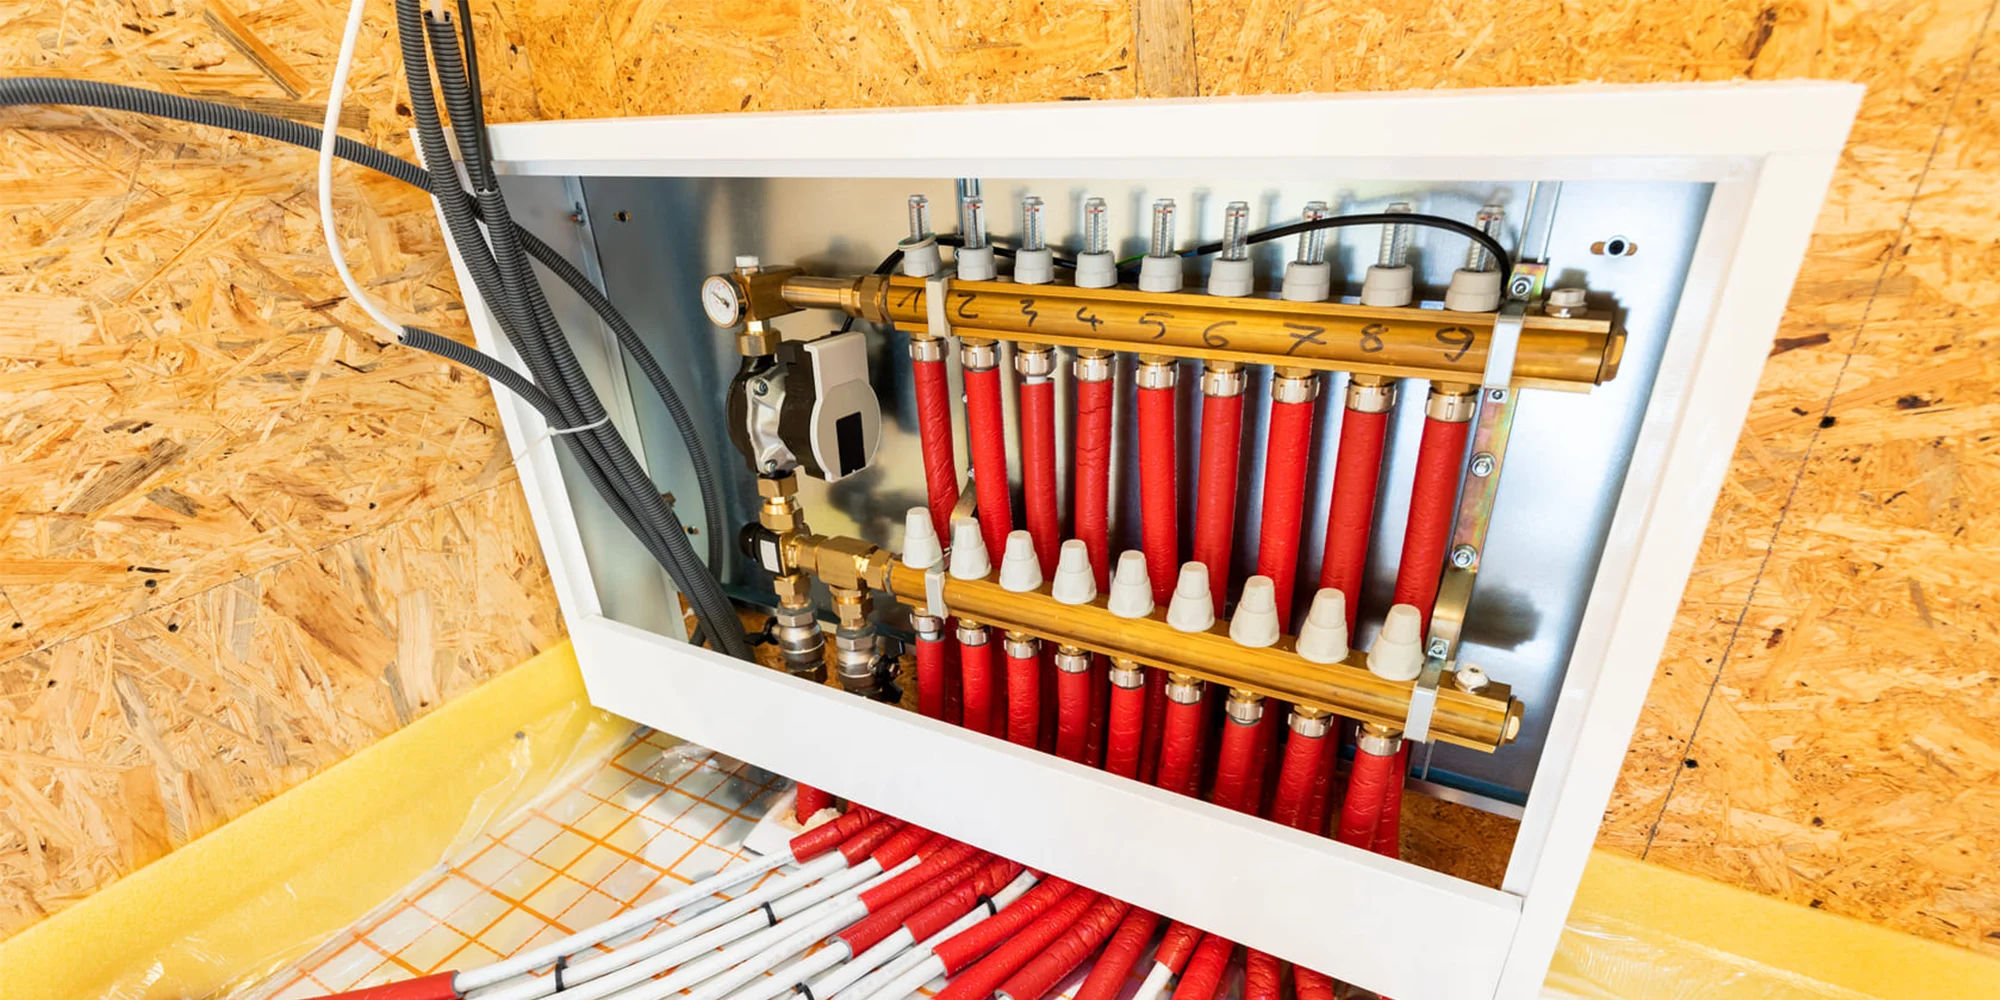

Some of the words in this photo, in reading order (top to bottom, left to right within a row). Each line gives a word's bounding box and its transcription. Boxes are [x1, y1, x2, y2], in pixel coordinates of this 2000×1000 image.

[897, 287, 922, 313] 1
[957, 293, 978, 319] 2
[1020, 299, 1038, 327] 3
[1076, 306, 1103, 331] 4
[1138, 311, 1175, 340] 5
[1202, 320, 1237, 348] 6
[1283, 322, 1327, 355] 7
[1360, 323, 1389, 353] 8
[1435, 326, 1475, 363] 9
